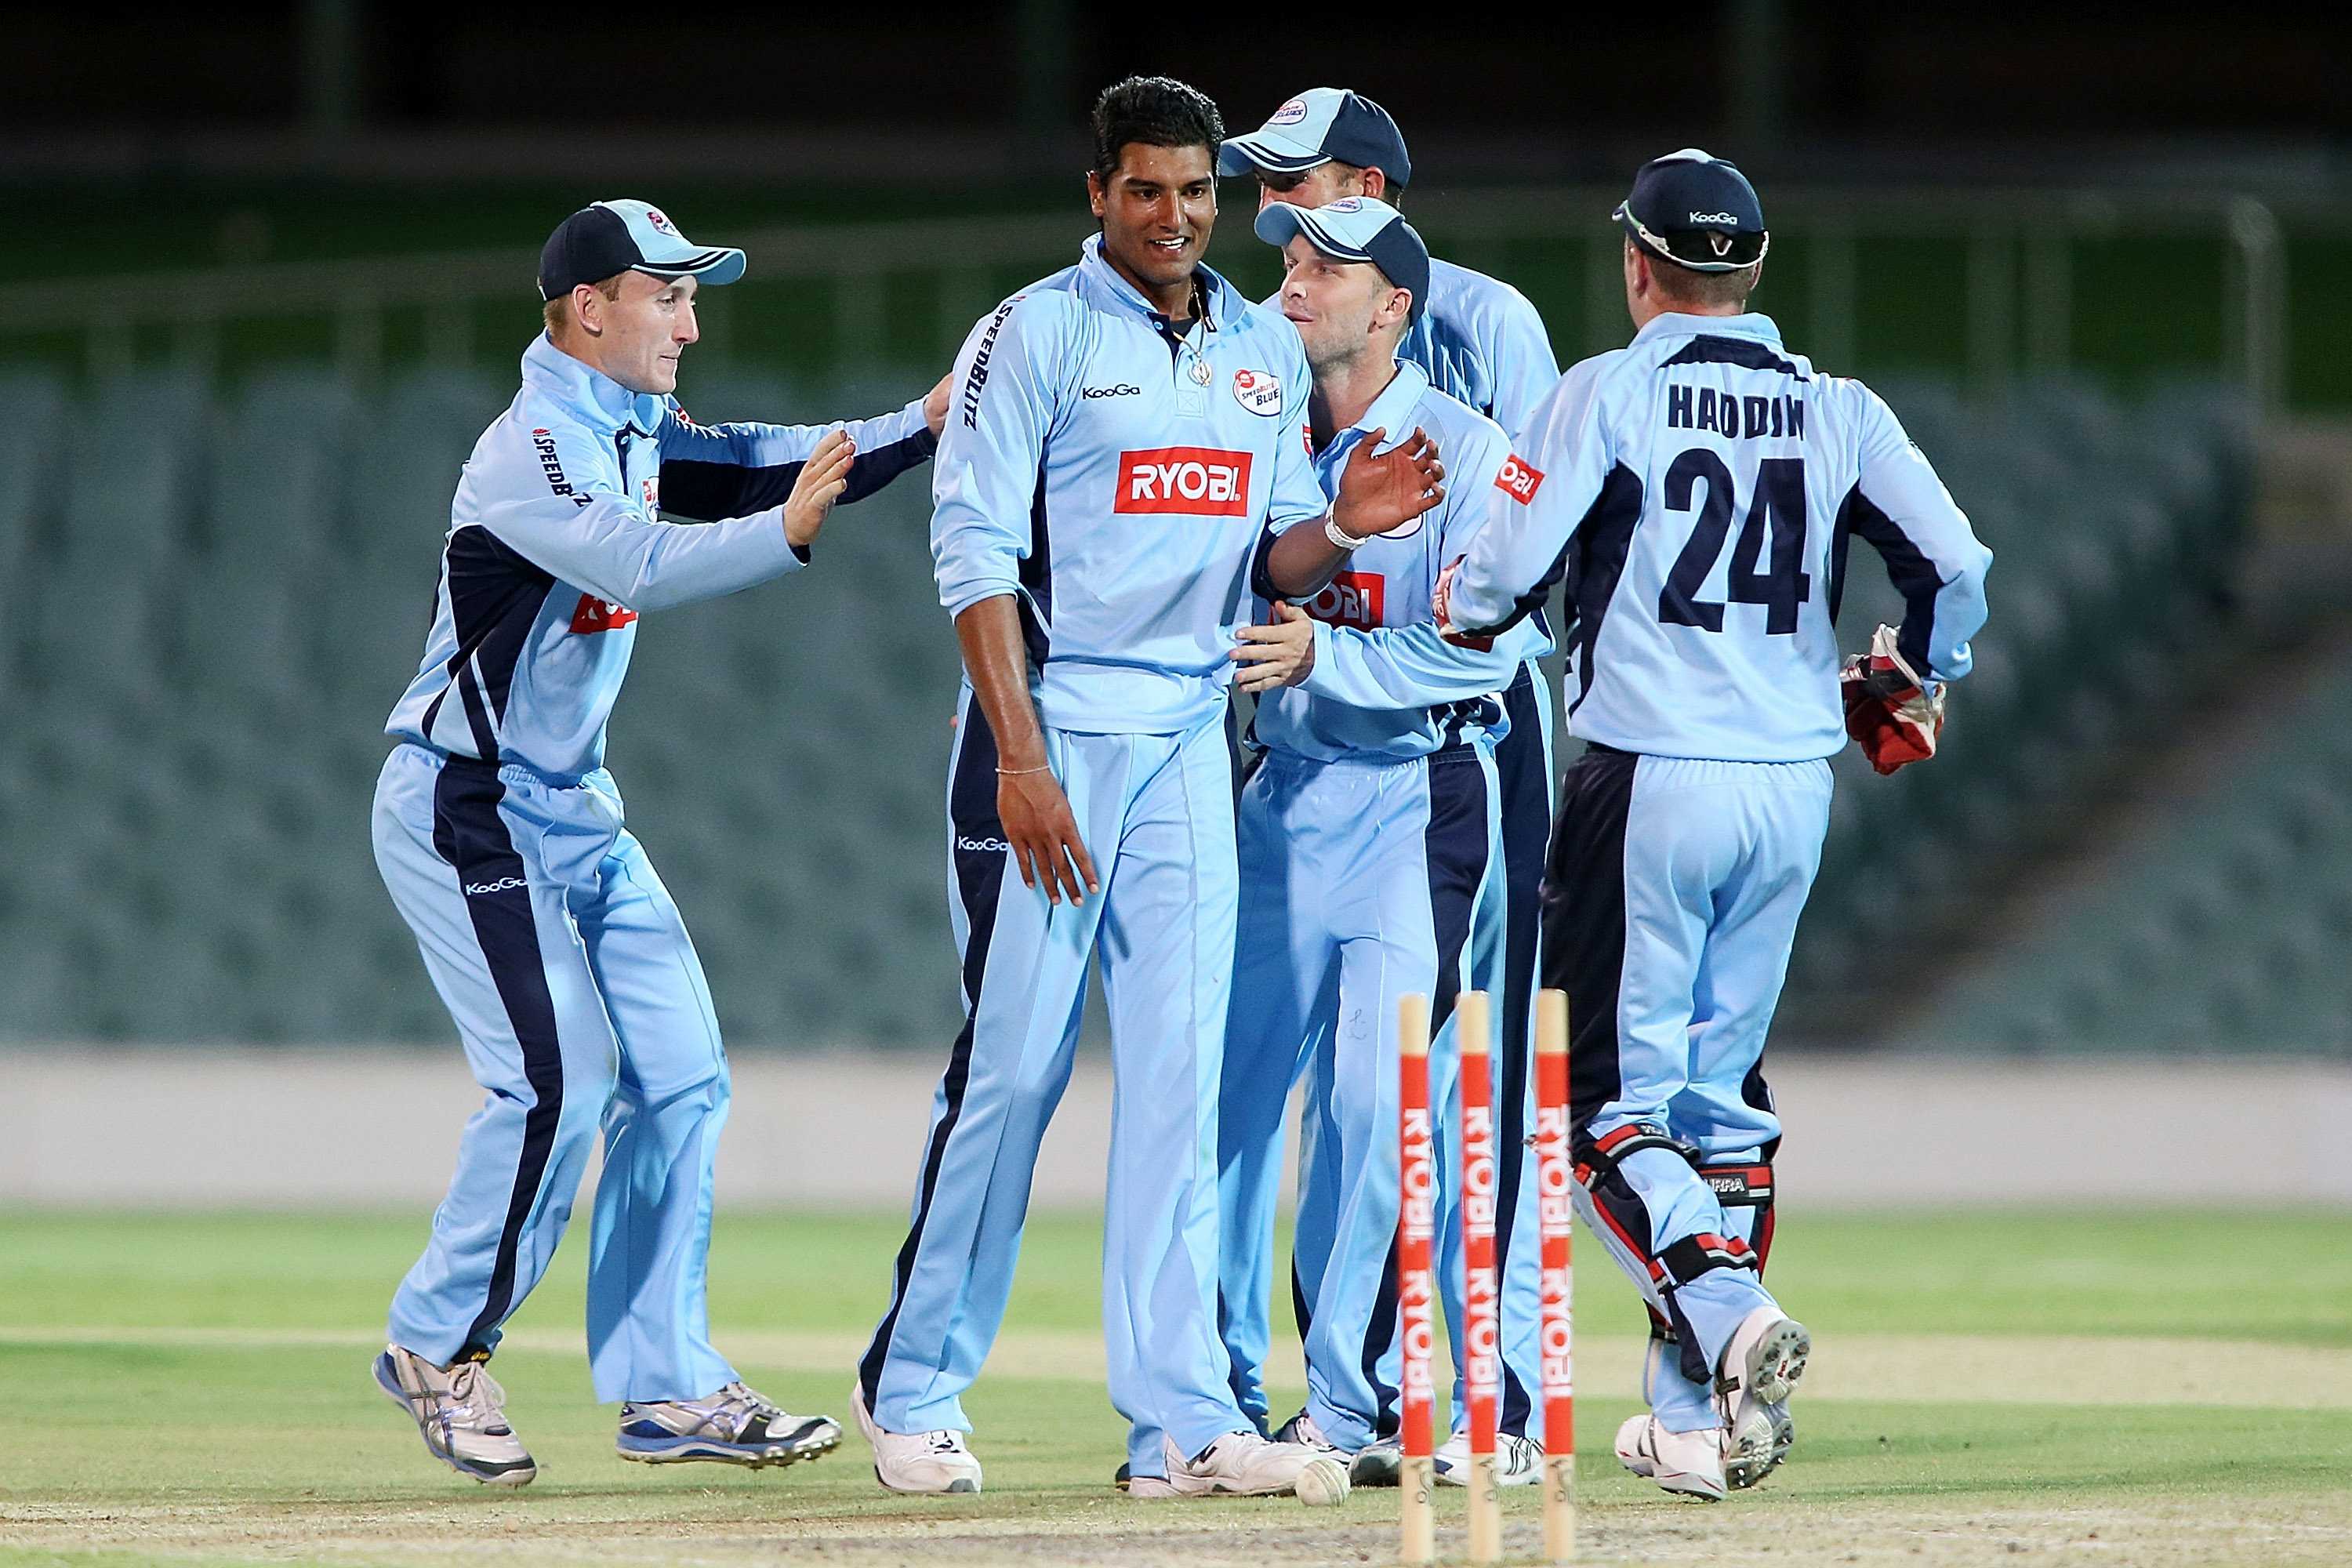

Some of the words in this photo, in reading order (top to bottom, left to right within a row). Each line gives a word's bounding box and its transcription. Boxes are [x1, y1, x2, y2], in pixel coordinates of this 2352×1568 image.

[1690, 211, 1738, 226] KooGa
[964, 303, 1014, 431] SPEEDBLITZ
[1082, 383, 1141, 400] KooGa
[1256, 388, 1280, 406] BLUE
[1668, 383, 1804, 441] HADDIN
[1131, 461, 1240, 503] RYOBI
[1500, 461, 1536, 495] OBI
[1658, 448, 1811, 635] 24
[1309, 583, 1370, 624] OBI
[957, 836, 1009, 851] KooGa
[465, 877, 528, 895] KooGa
[1403, 1106, 1434, 1238] RYOBI
[1465, 1105, 1497, 1237] RYOBI
[1539, 1103, 1572, 1237] RYOBI
[1404, 1269, 1436, 1399] RYOBI
[1468, 1267, 1498, 1398] RYOBI
[1541, 1265, 1573, 1398] RYOBI
